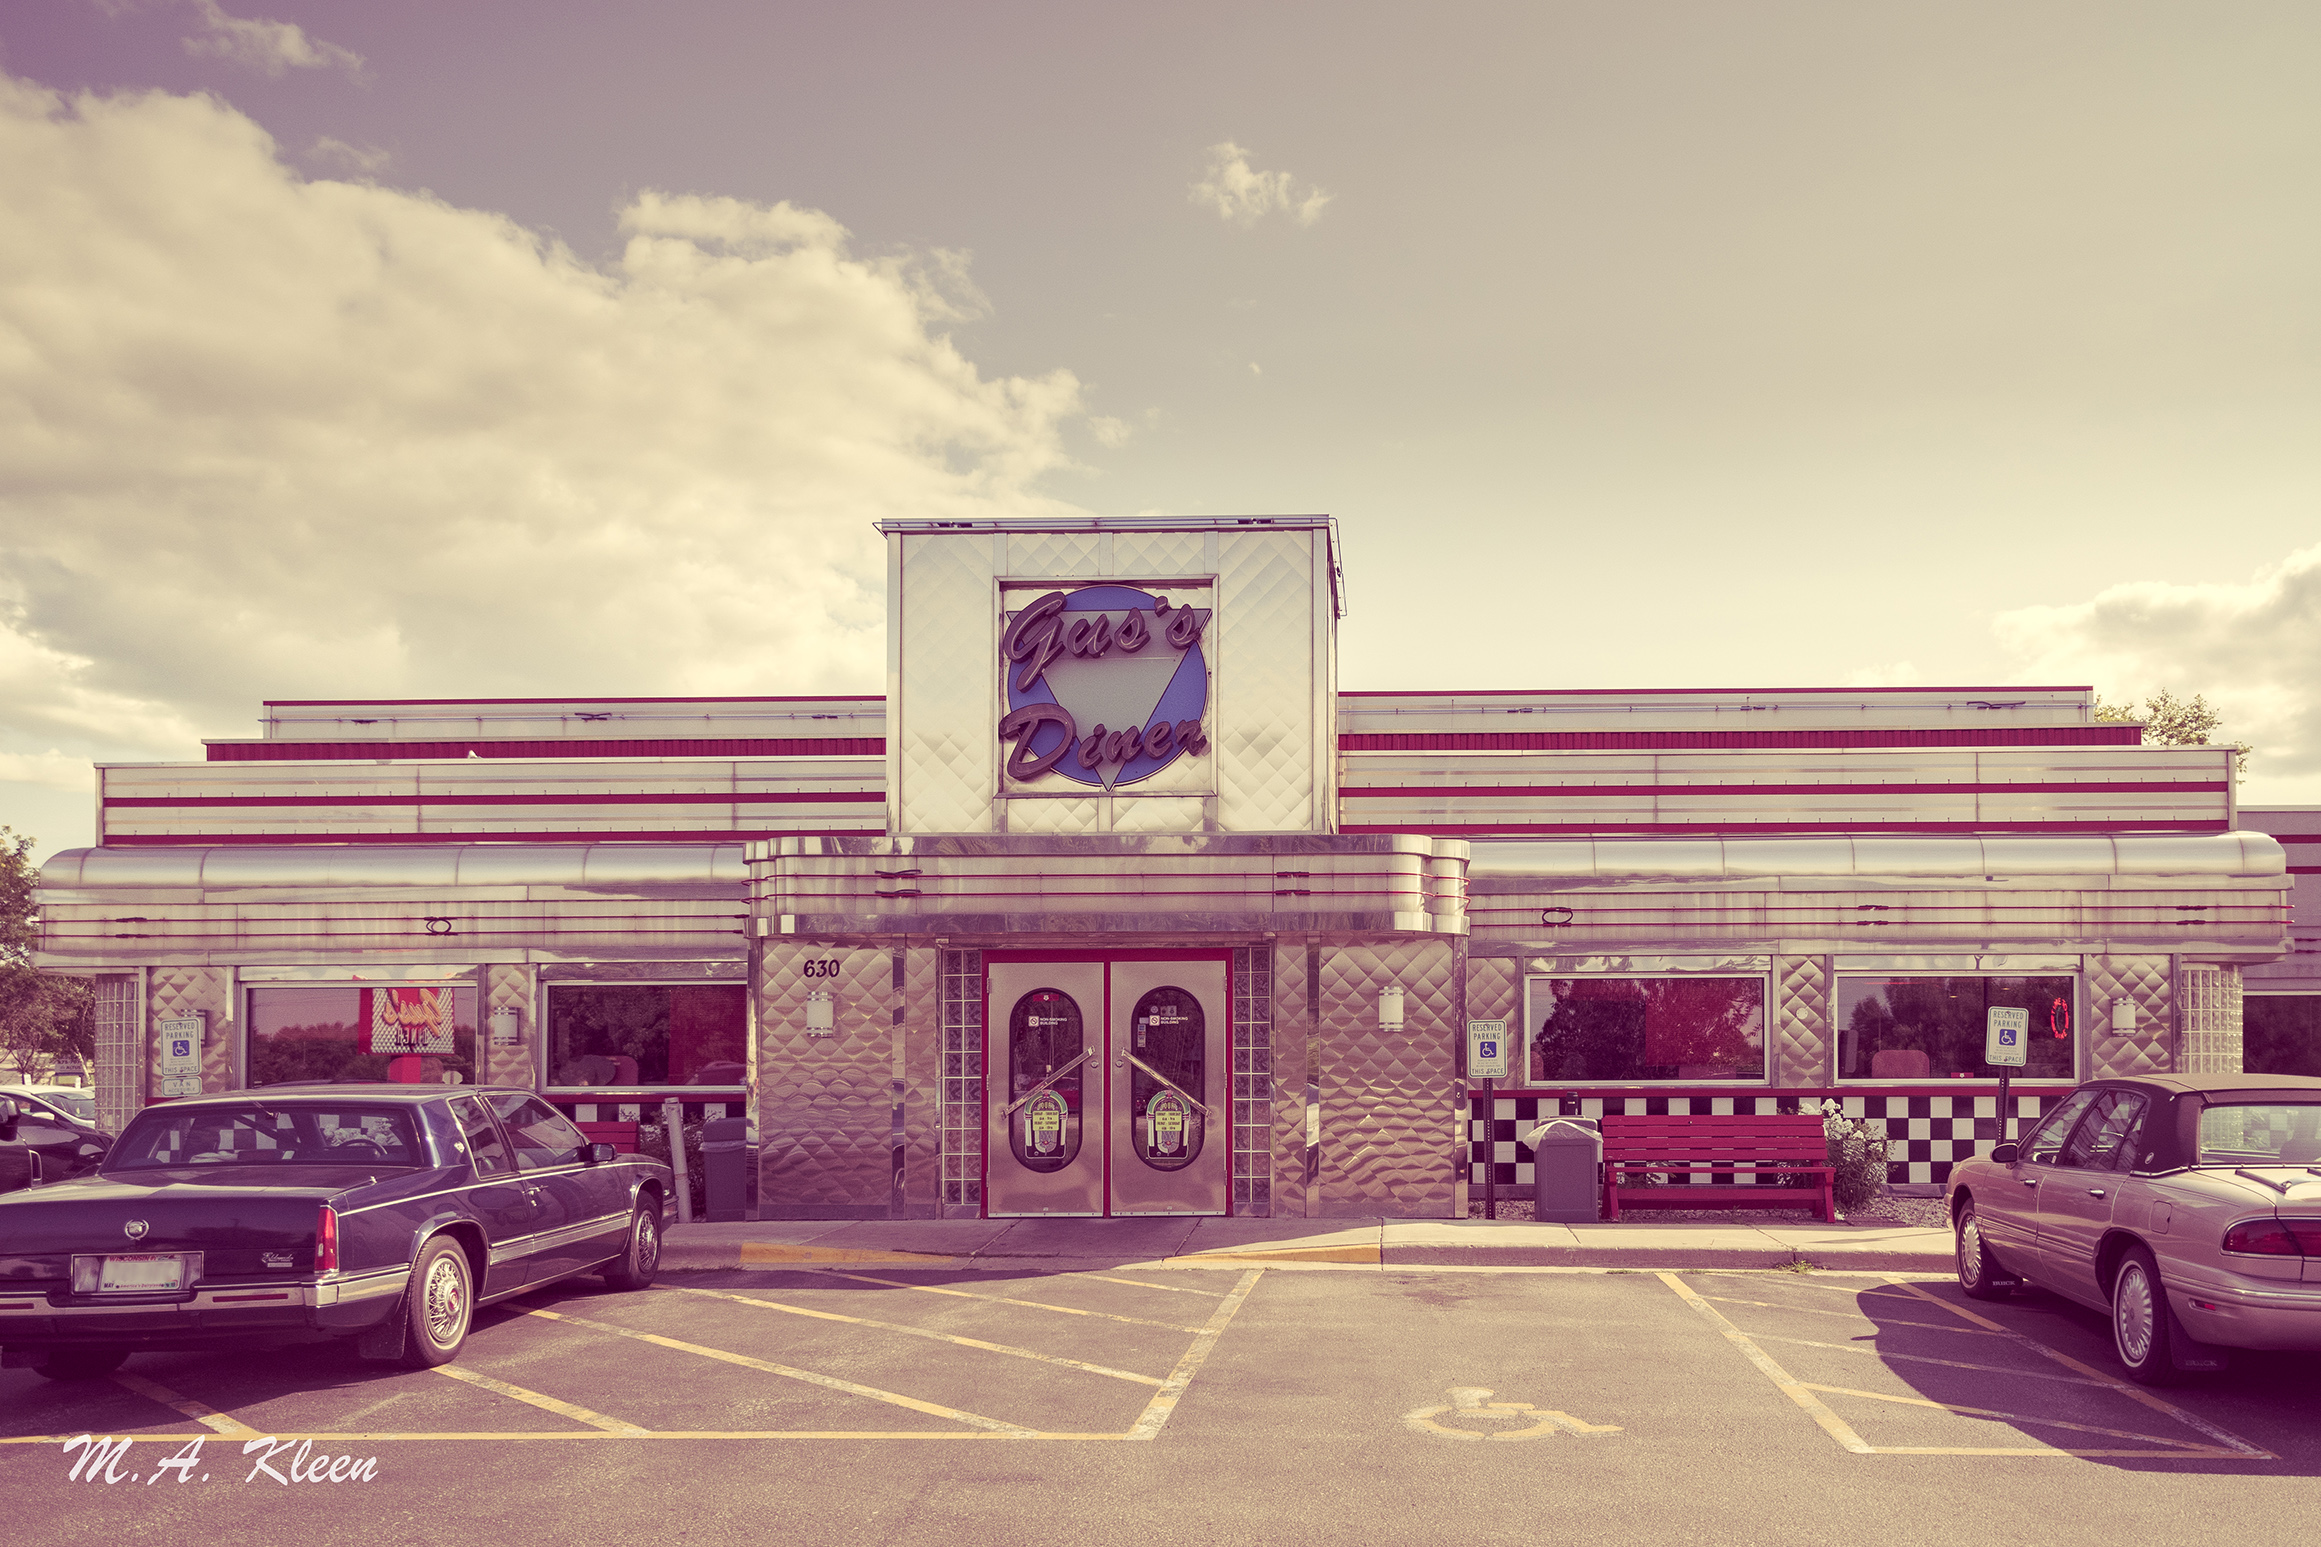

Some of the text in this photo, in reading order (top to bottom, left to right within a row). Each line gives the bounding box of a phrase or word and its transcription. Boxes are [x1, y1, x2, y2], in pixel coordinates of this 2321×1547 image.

[1004, 591, 1200, 693] Gus's
[999, 703, 1207, 780] Diner
[803, 959, 840, 978] 630
[1993, 1010, 2024, 1020] RESERVED
[165, 1022, 195, 1031] RESERVED
[1472, 1023, 1502, 1032] RESERVED
[1993, 1020, 2022, 1028] PARKING
[166, 1031, 194, 1039] PARKING
[1473, 1032, 1501, 1040] PARKING
[2004, 1055, 2023, 1063] SPACE
[1486, 1067, 1503, 1075] SPACE
